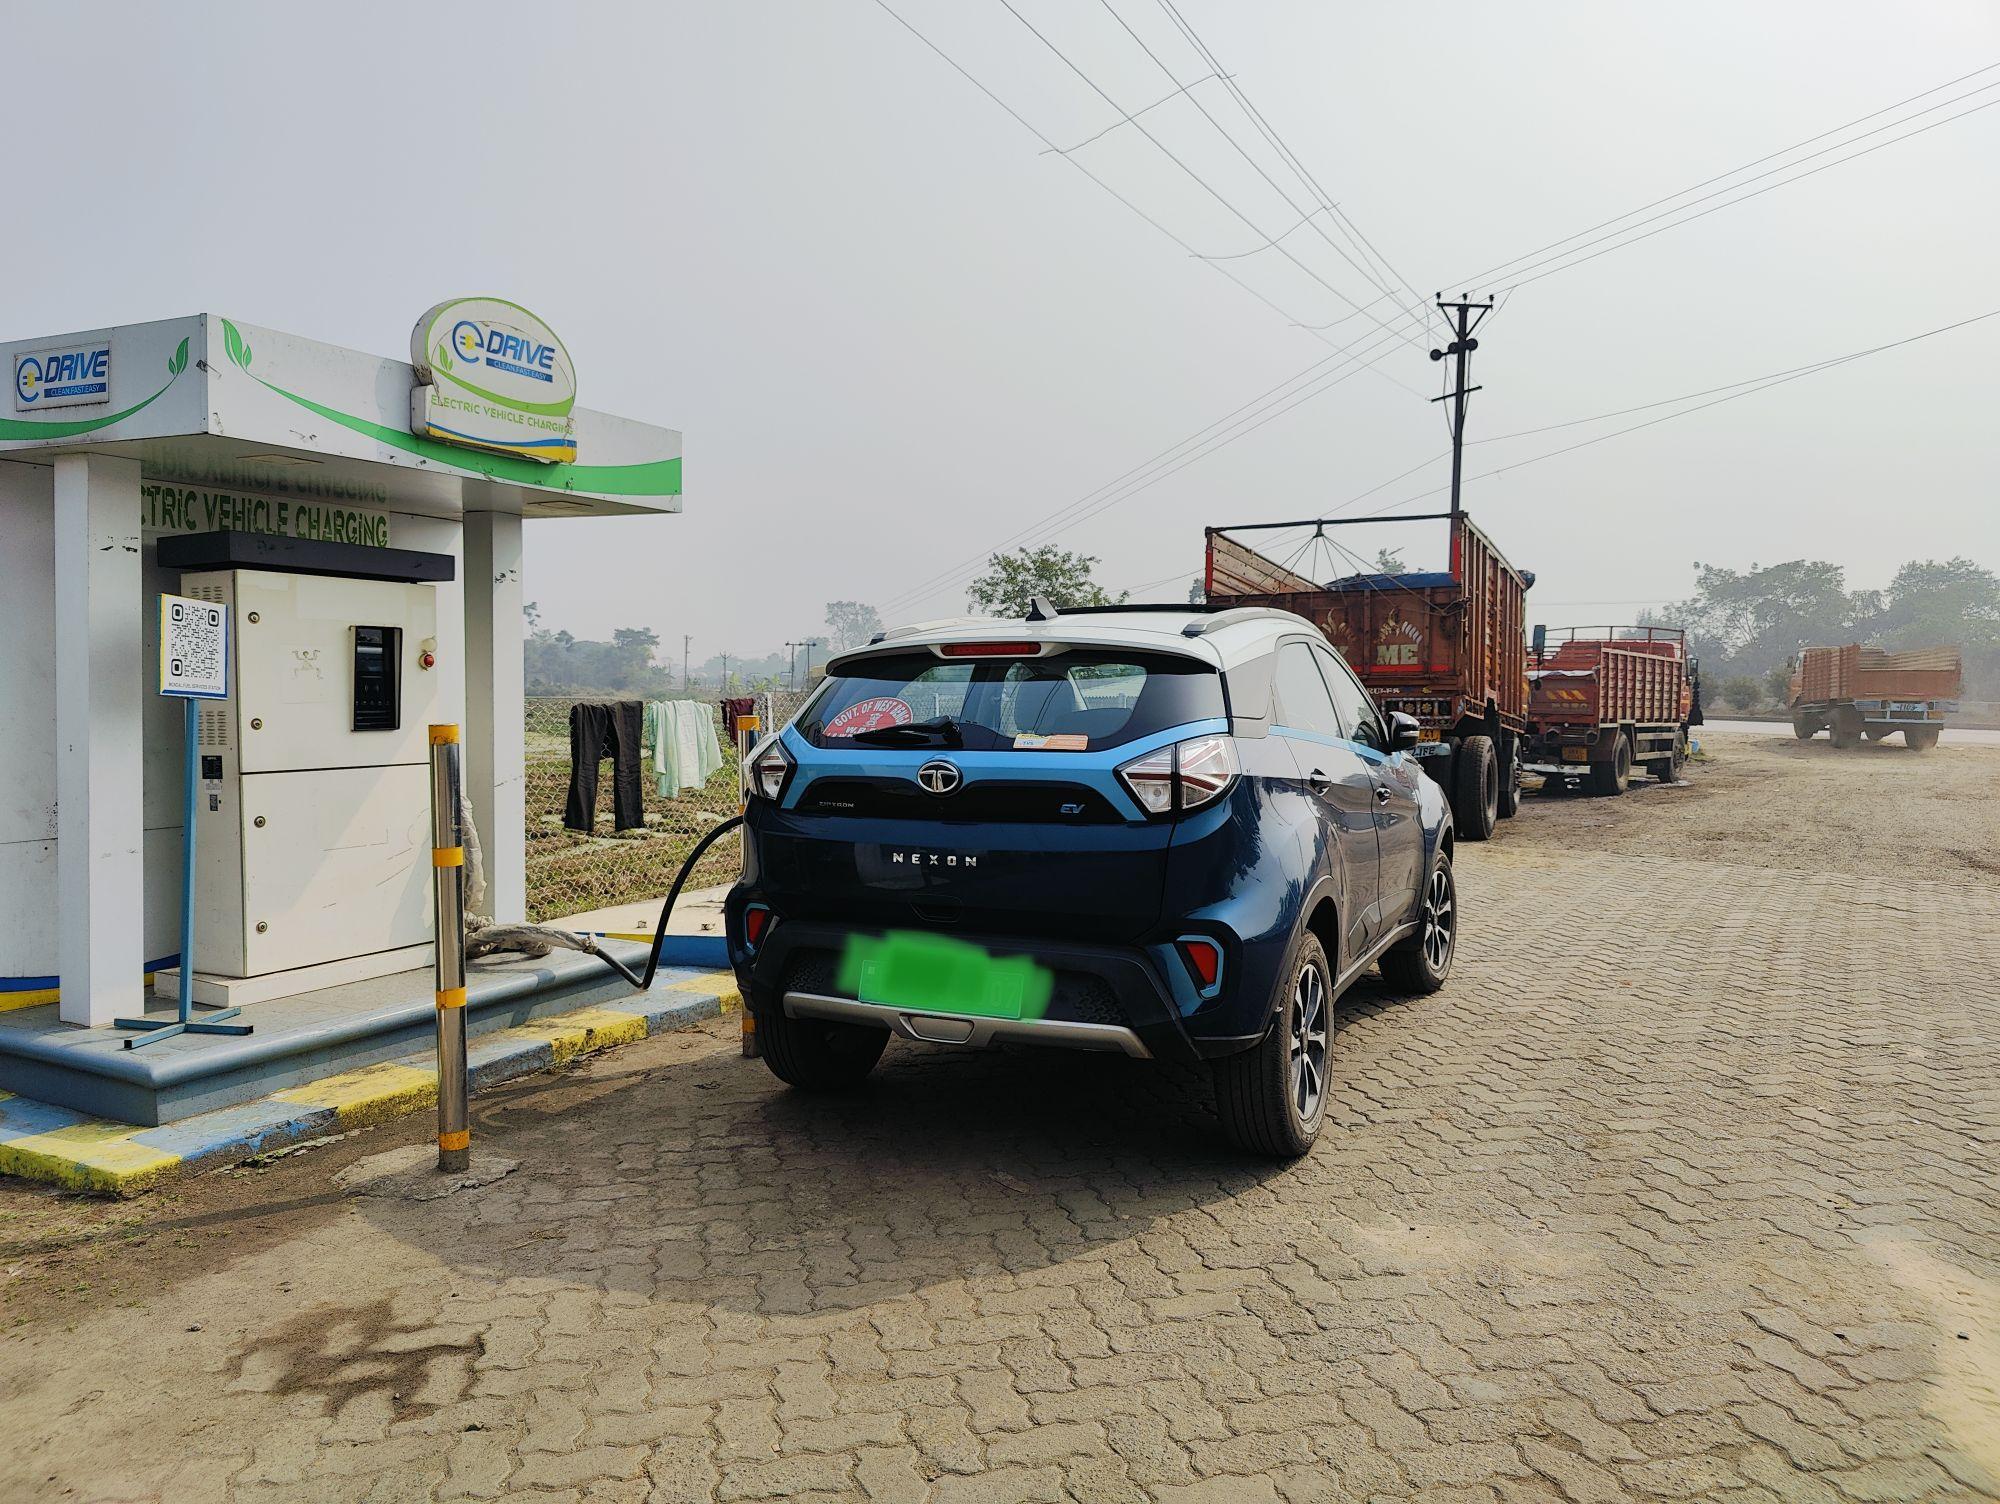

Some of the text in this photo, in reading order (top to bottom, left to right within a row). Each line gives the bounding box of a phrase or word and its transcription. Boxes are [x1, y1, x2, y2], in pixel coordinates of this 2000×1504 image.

[861, 701, 874, 714] OF
[1060, 803, 1086, 814] EV
[892, 852, 977, 867] NEXON
